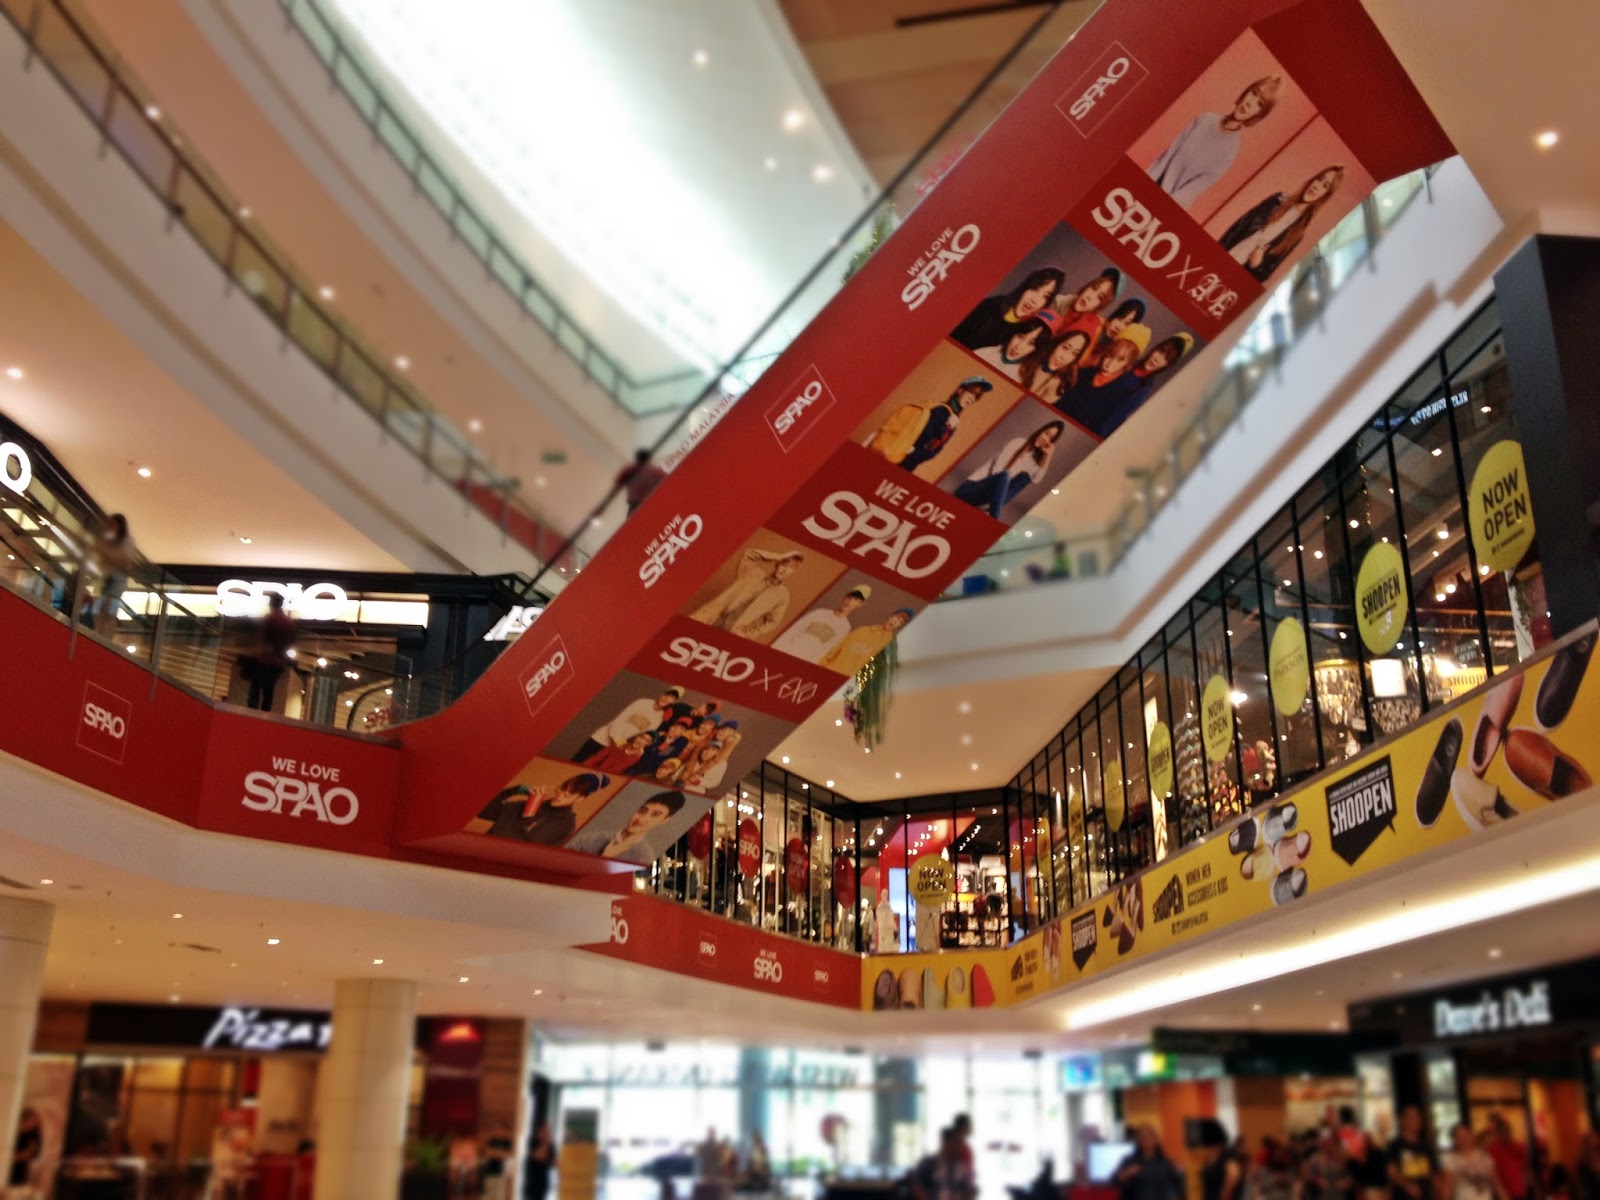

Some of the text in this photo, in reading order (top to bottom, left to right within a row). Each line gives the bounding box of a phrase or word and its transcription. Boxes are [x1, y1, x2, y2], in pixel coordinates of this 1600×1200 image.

[1069, 57, 1130, 120] SPAO
[906, 227, 954, 276] WE LOVE
[1091, 187, 1181, 269] SPAO
[901, 224, 981, 311] SPAO
[774, 381, 823, 435] SPAO
[875, 479, 956, 530] WE LOVE
[1481, 467, 1519, 514] NOW
[644, 513, 683, 556] WE LOVE
[802, 490, 951, 579] SPAO
[1483, 493, 1528, 542] OPEN
[639, 513, 703, 589] SPAO
[1361, 573, 1401, 620] SHOOPEN
[525, 651, 566, 698] SPAO
[660, 635, 755, 684] SPAO
[83, 702, 125, 739] SPAO
[1206, 696, 1226, 719] NOW
[1207, 715, 1229, 740] OPEN
[272, 757, 341, 783] WE LOVE
[241, 771, 360, 826] SPAO
[1330, 778, 1394, 838] SHOOPEN
[917, 880, 947, 892] OPEN
[919, 868, 945, 879] NOW
[700, 941, 716, 957] SPAO
[753, 957, 783, 984] SPAO
[814, 969, 829, 983] SPAO
[202, 1007, 313, 1051] Pizza
